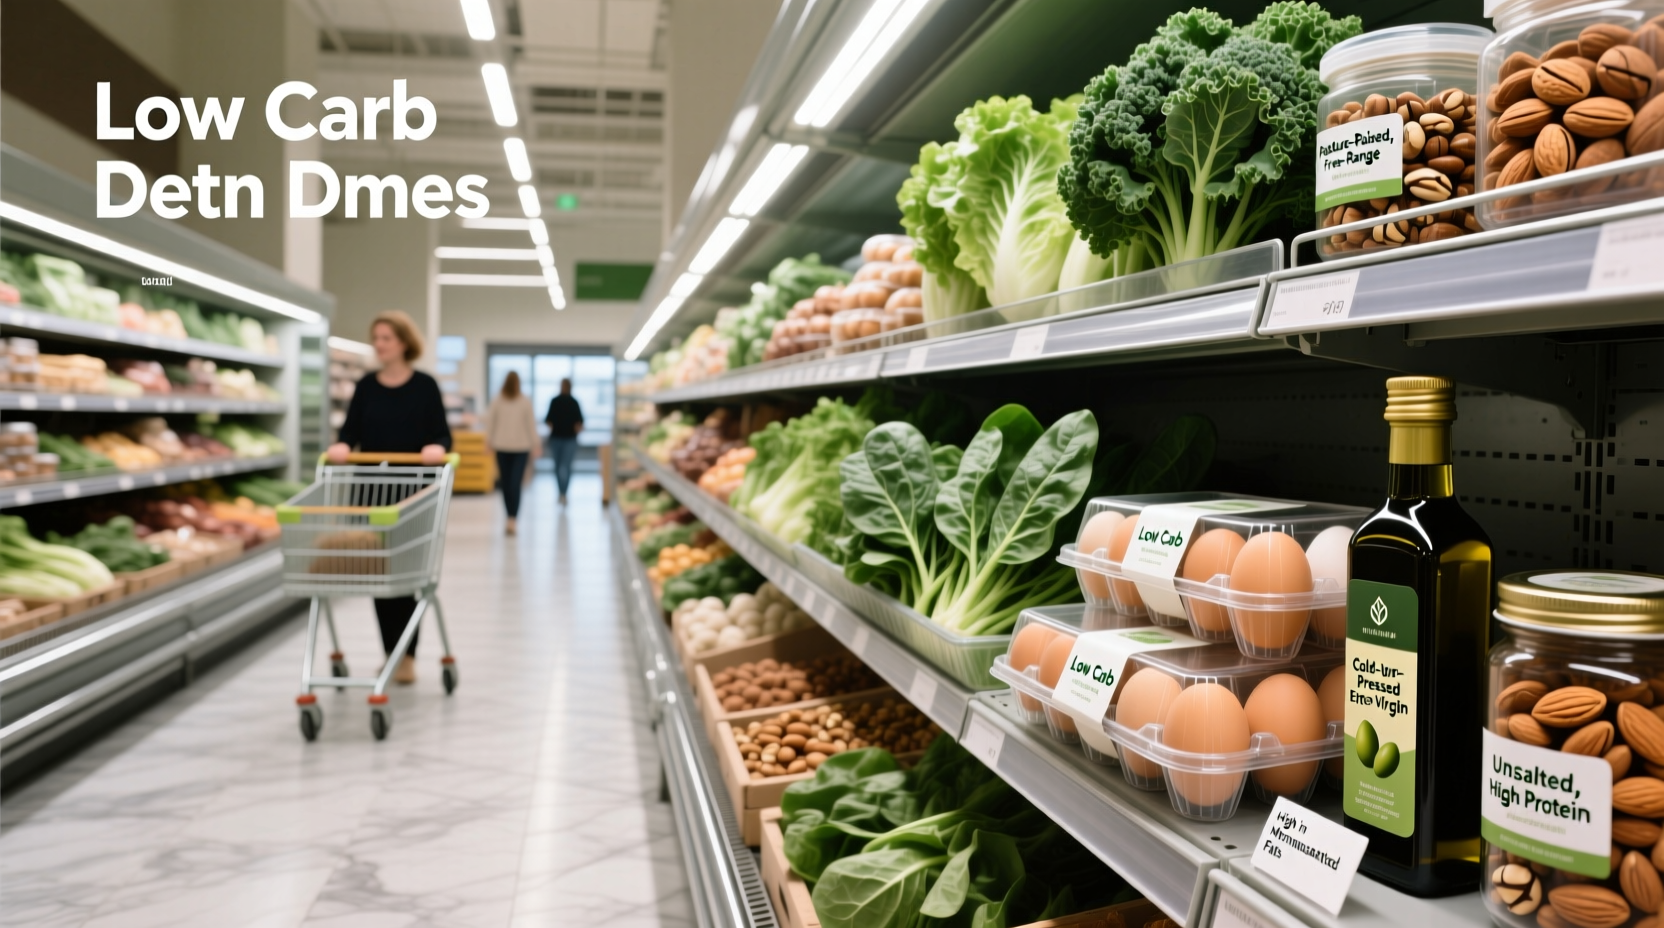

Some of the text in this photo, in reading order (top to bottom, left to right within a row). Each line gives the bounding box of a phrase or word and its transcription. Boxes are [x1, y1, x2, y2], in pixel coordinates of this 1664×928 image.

[1070, 655, 1091, 676] Low
[1375, 695, 1408, 718] Virgin
[1493, 754, 1581, 799] Unsalted,
[1490, 778, 1520, 808] High
[1524, 789, 1591, 824] Protein
